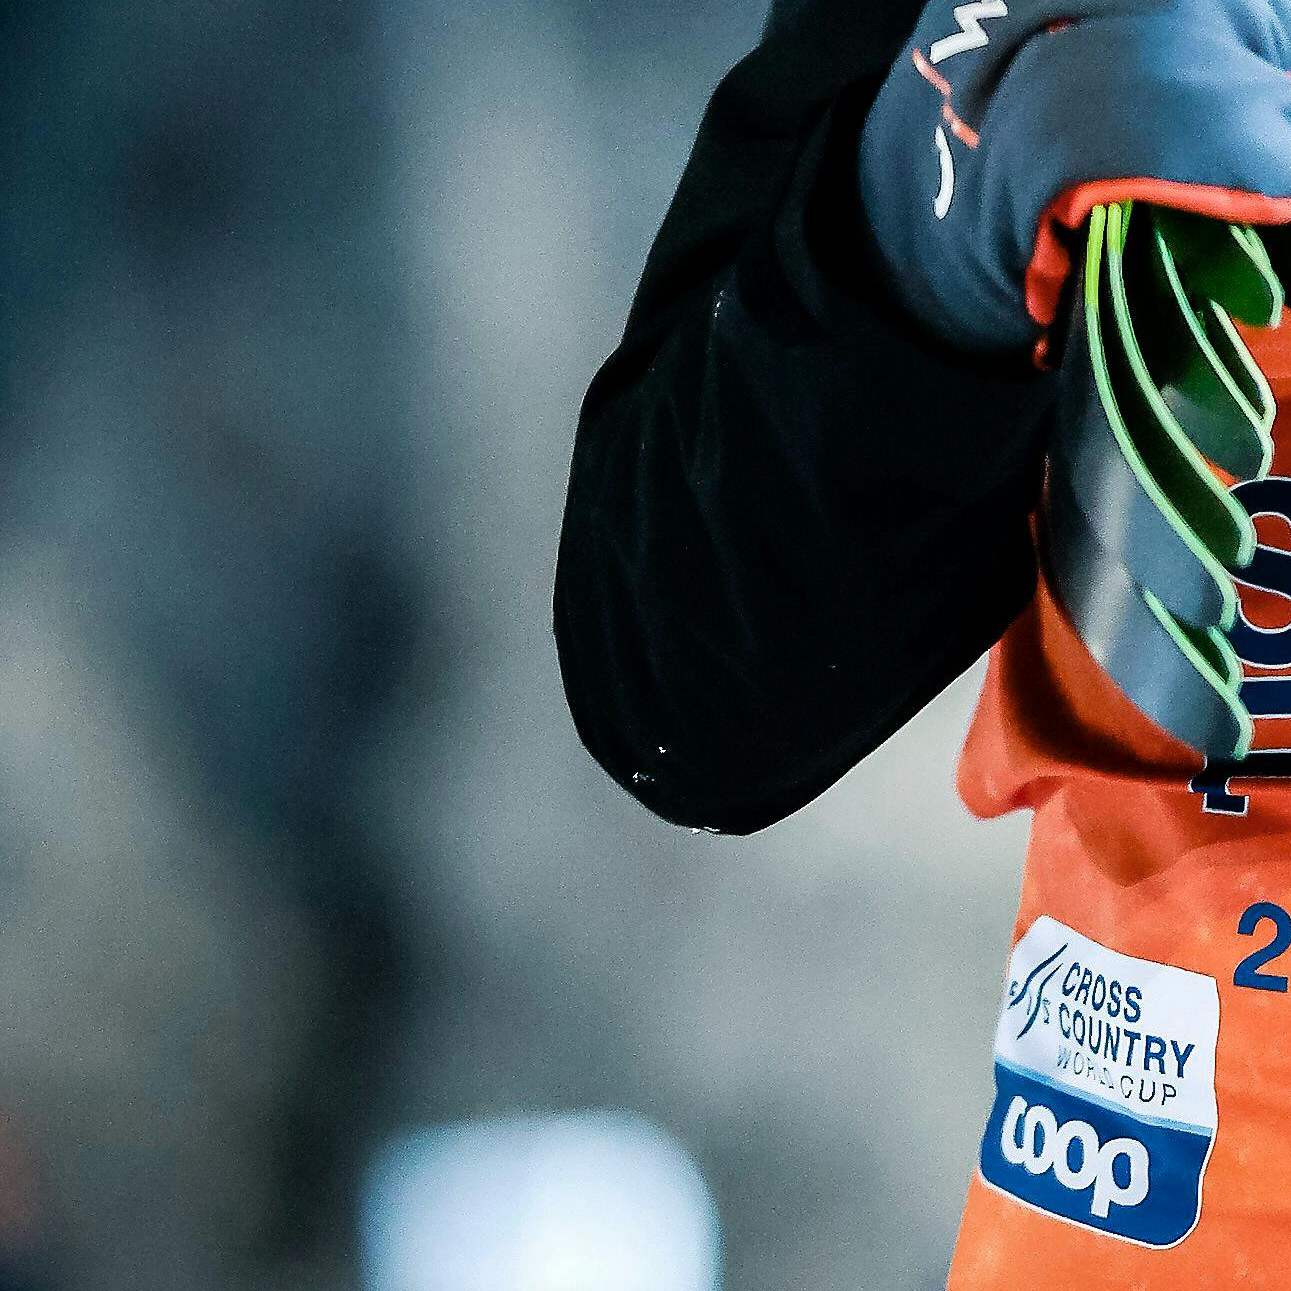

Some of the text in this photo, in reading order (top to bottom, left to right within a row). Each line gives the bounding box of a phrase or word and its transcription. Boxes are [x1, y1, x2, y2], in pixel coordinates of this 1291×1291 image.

[1062, 961, 1143, 1024] CROSS
[1057, 1005, 1196, 1080] COUNTRY
[1120, 1075, 1178, 1106] CUP
[1000, 1095, 1151, 1218] coop
